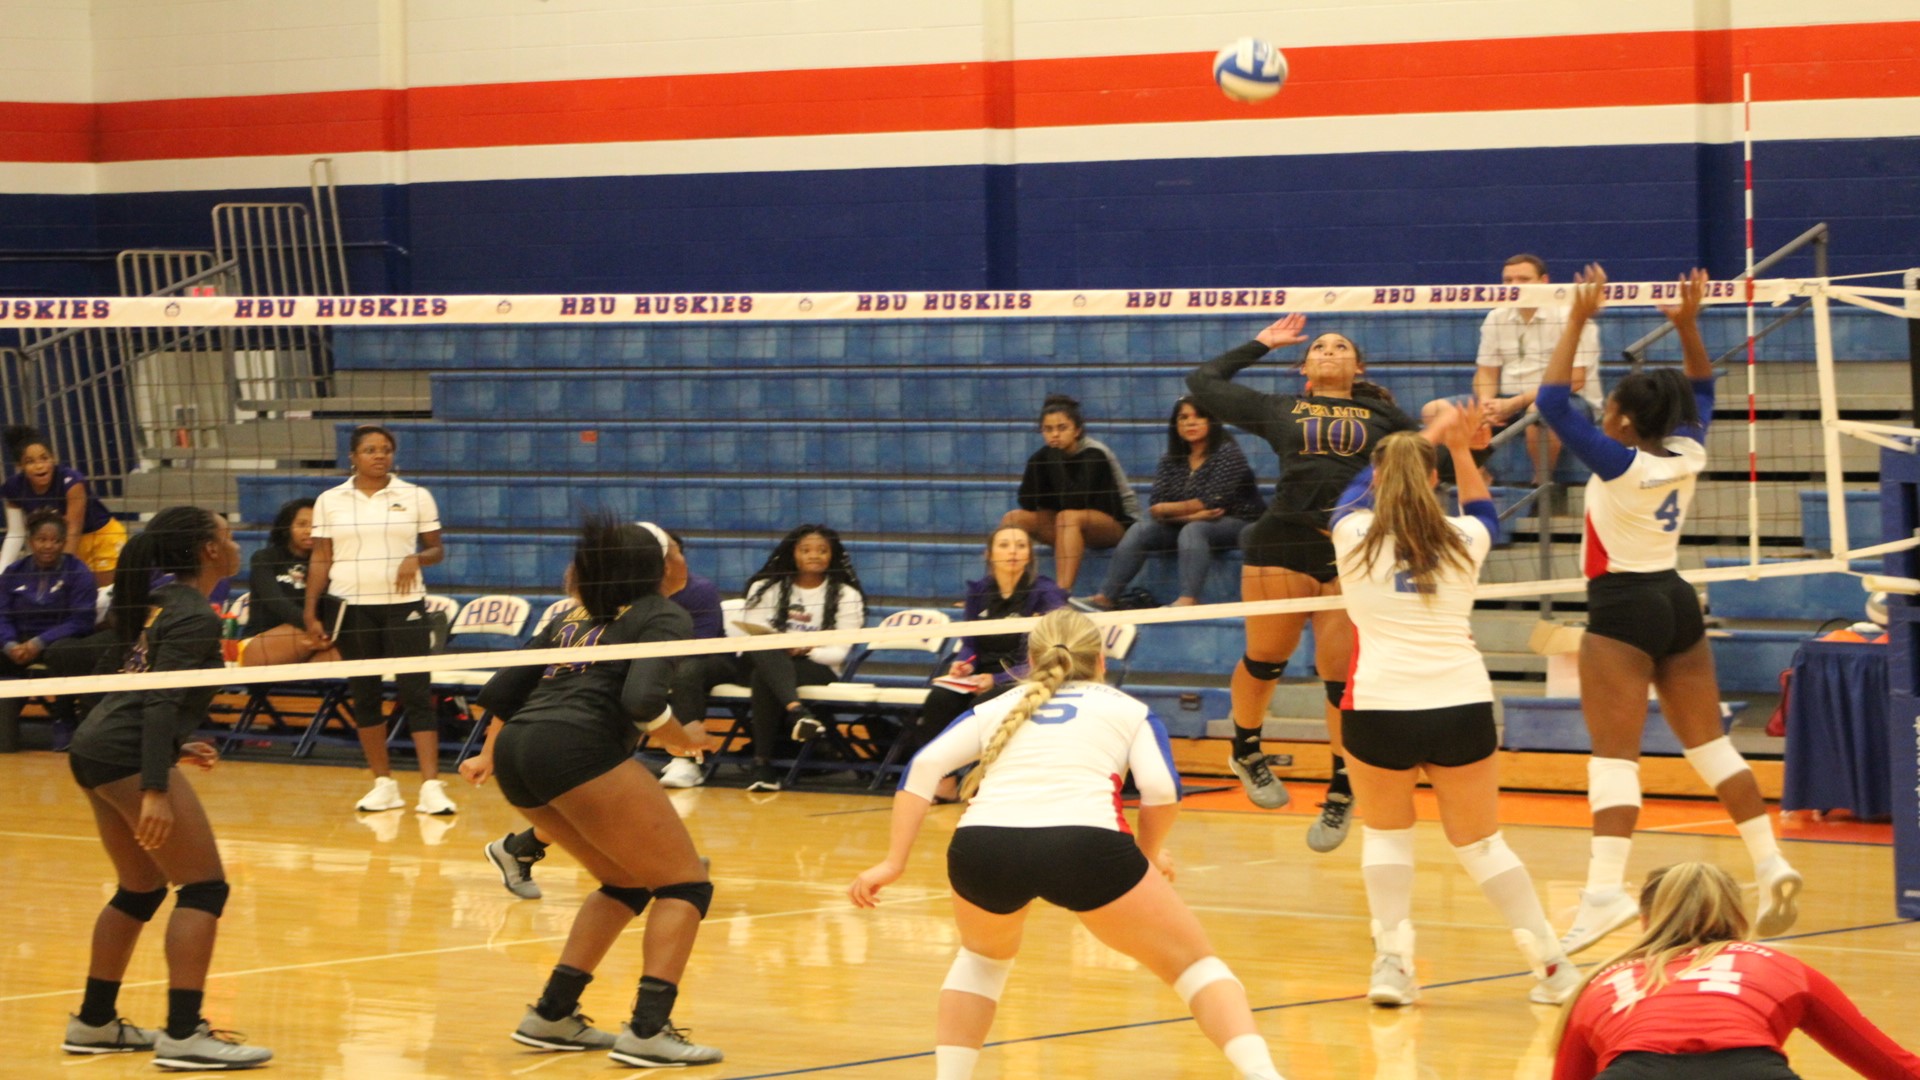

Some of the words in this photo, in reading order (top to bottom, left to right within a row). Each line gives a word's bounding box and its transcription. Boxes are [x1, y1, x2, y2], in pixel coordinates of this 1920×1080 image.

[1126, 291, 1172, 308] HBU
[1187, 290, 1287, 307] HUSKIES
[1373, 288, 1416, 304] HBU
[1429, 286, 1521, 303] HUSKIES
[1651, 282, 1735, 299] HUIES
[234, 299, 296, 318] HBU
[316, 298, 448, 317] HUSKIES
[560, 297, 616, 315] HBU
[634, 296, 753, 314] HUSKIES
[856, 294, 908, 312] HBU
[924, 293, 1032, 311] HUSKIES
[1296, 416, 1367, 456] 10
[1655, 488, 1680, 532] 4
[465, 600, 519, 626] HBU
[1030, 693, 1084, 725] 5
[1602, 954, 1743, 1014] 14
